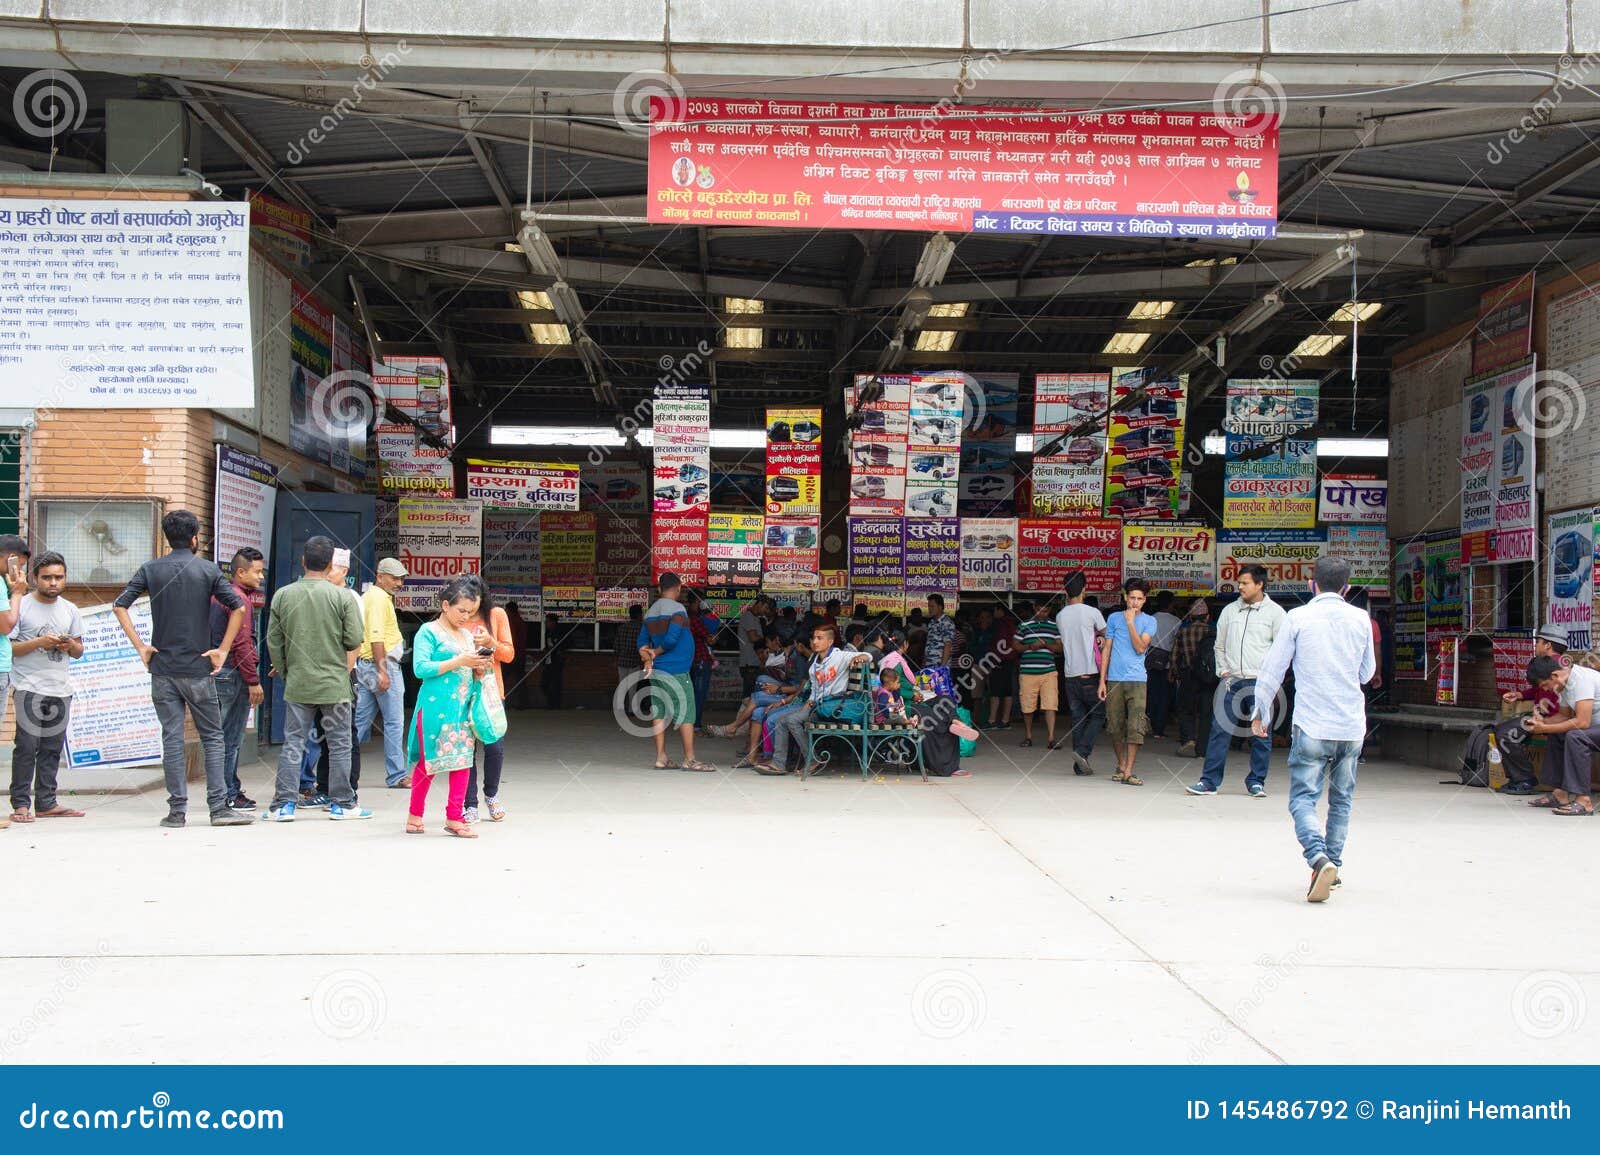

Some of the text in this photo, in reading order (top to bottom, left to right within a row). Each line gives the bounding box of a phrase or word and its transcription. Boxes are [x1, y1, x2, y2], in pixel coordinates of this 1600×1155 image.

[688, 102, 718, 116] २०७३
[726, 101, 763, 115] सालको
[768, 101, 803, 115] विजया
[808, 103, 838, 117] दशमी
[843, 106, 864, 118] तथा
[1107, 113, 1125, 126] छठ
[1131, 112, 1161, 126] पर्वको
[1167, 115, 1194, 127] पावन
[1055, 129, 1088, 146] हार्दिक
[1142, 135, 1197, 150] शुभकामना
[1201, 136, 1229, 148] व्यक्त
[671, 138, 692, 153] साथै
[697, 143, 715, 154] यस
[721, 143, 768, 156] अवसरमा
[774, 142, 810, 159] पूर्वदेखि
[949, 148, 991, 163] चापलाई
[996, 151, 1045, 164] मध्यनजर
[1051, 150, 1071, 165] गरी
[1076, 151, 1095, 165] यही
[1101, 154, 1130, 168] २०७३
[1138, 155, 1160, 167] साल
[1212, 158, 1219, 167] ७
[1227, 155, 1262, 168] गतेबाट
[804, 164, 835, 178] अग्रिम
[841, 165, 871, 179] टिकट
[913, 169, 943, 184] खुल्ला
[948, 167, 976, 182] गरिने
[982, 169, 1029, 184] जानकारी
[1034, 170, 1060, 184] समेत
[657, 188, 693, 203] लोत्से
[824, 191, 847, 206] नेपाल
[850, 195, 883, 207] यातायात
[886, 194, 920, 208] व्यवसायी
[1002, 197, 1044, 210] नारायणी
[1085, 198, 1117, 213] परिवार
[16, 208, 52, 226] प्रहरी
[56, 208, 87, 225] पोष्ट
[123, 209, 193, 227] बसपार्कको
[196, 209, 246, 231] अनुरोध
[1136, 201, 1179, 215] नारायणी
[1240, 202, 1273, 218] परिवार
[33, 231, 77, 243] लगेजका
[81, 234, 103, 244] साथ
[106, 232, 125, 244] कतै
[128, 234, 153, 244] यात्रा
[975, 216, 999, 230] नोट
[1010, 216, 1044, 231] टिकट
[1081, 221, 1113, 233] समय
[1117, 222, 1127, 234] र
[1130, 219, 1173, 235] मितिको
[1177, 223, 1212, 237] ख्याल
[1217, 222, 1267, 239] गर्नुहोला
[539, 477, 577, 489] बेनी
[1323, 480, 1388, 507] पोख
[1127, 531, 1213, 552] धनगढी
[962, 552, 1013, 573] धनगढी
[1551, 602, 1591, 624] Kakarvitta
